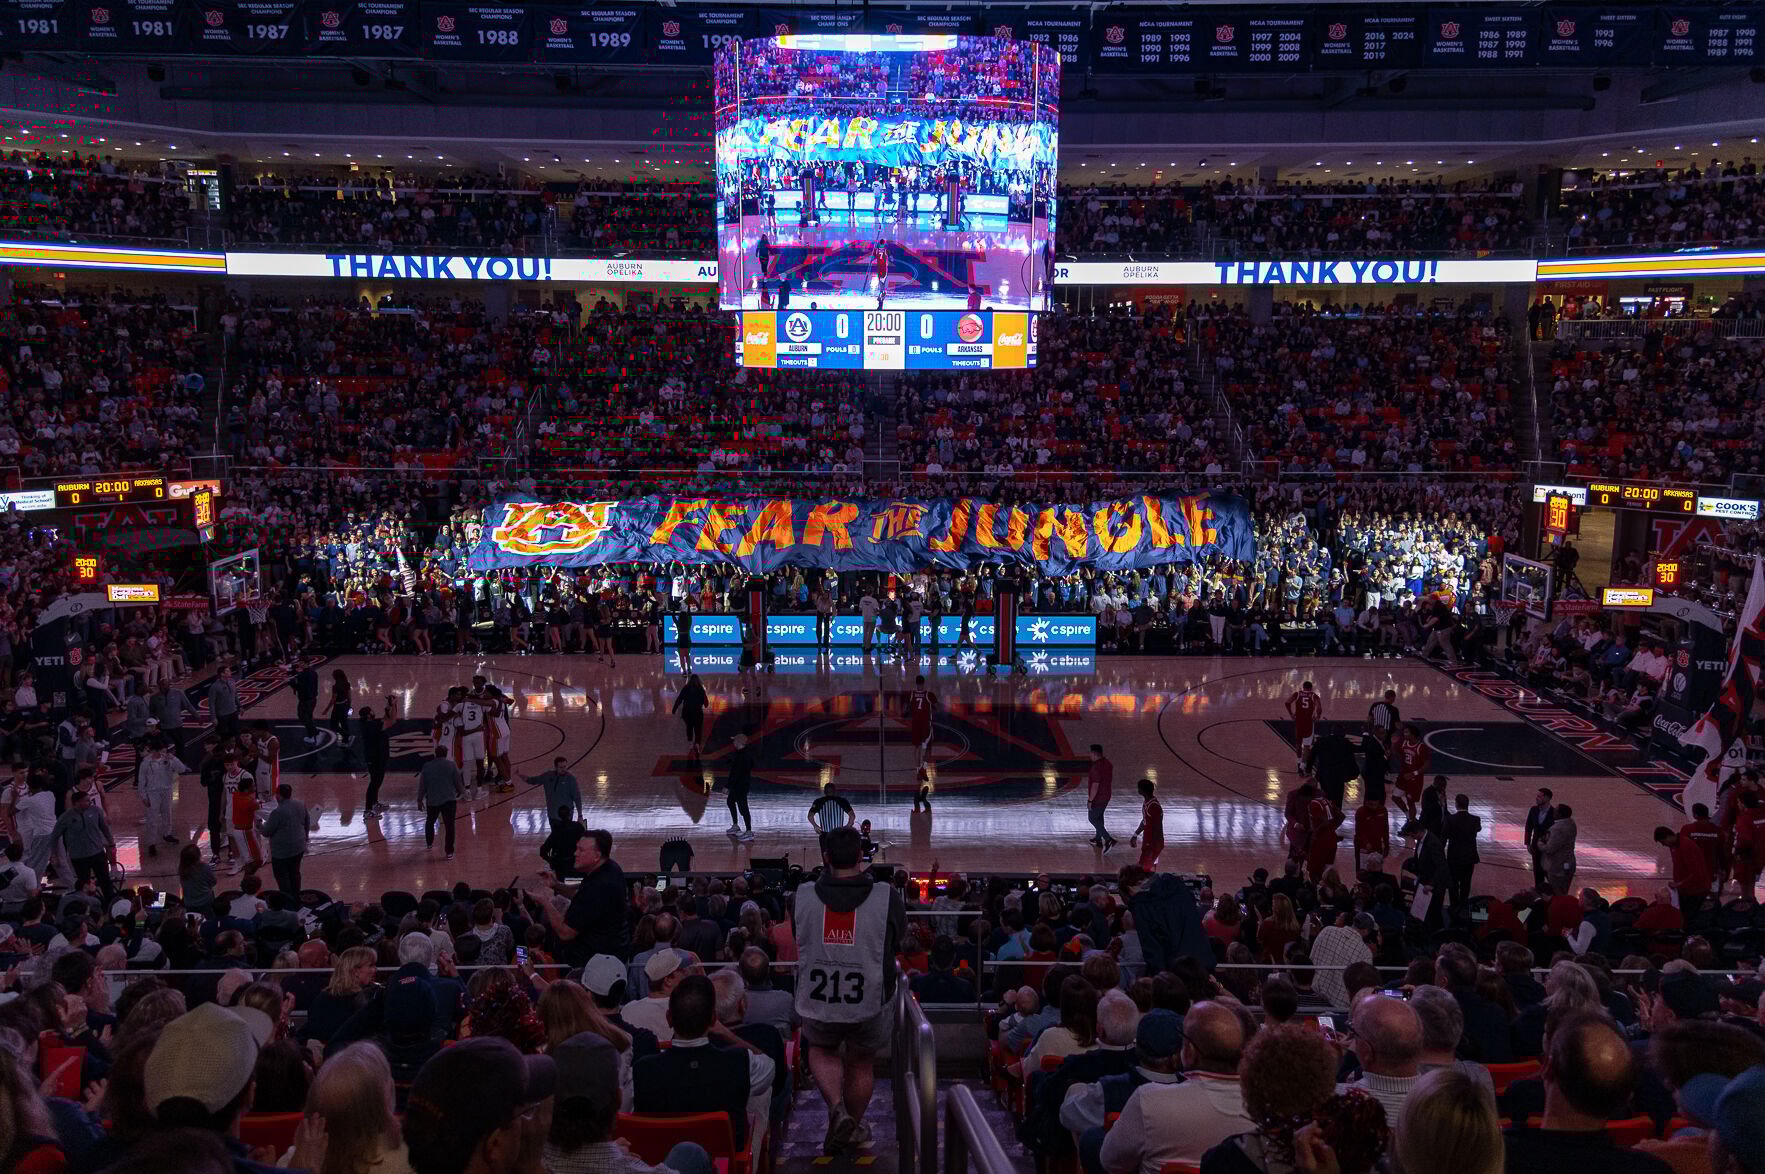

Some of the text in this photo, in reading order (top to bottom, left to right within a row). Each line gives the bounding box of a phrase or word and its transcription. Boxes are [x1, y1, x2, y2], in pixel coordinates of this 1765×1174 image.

[18, 19, 58, 34] 1981
[132, 21, 173, 36] 1981
[247, 24, 289, 39] 1987
[362, 25, 404, 40] 1987
[477, 30, 519, 45] 1988
[1252, 33, 1301, 41] 1997 2004
[1365, 32, 1386, 40] 2016
[1479, 31, 1500, 39] 1986
[1595, 29, 1614, 37] 1993
[590, 32, 631, 47] 1989
[1029, 34, 1079, 42] 1982 1986
[1141, 34, 1191, 42] 1989 1993
[1594, 39, 1613, 47] 1996
[1058, 44, 1079, 52] 1987
[1141, 44, 1191, 52] 1990 1994
[1251, 43, 1300, 51] 1999 2008
[1364, 42, 1386, 50] 2017
[1140, 54, 1190, 62] 1991 1996
[1249, 53, 1300, 61] 2000 2009
[1363, 52, 1385, 60] 2019
[1478, 50, 1524, 58] 1988 1991
[325, 254, 551, 280] THANK YOU!
[1215, 260, 1438, 284] THANK YOU!
[836, 313, 849, 339] 0
[867, 313, 901, 331] 20:00
[920, 313, 933, 339] 0
[788, 344, 808, 352] AUBURN
[957, 345, 983, 353] ARKANSAS
[58, 483, 90, 491] AUBURN
[95, 481, 129, 493] 20:00
[1590, 484, 1694, 499] AUBURN 20:00 ARKANSAS
[72, 493, 80, 504] 0
[155, 487, 163, 498] 0
[1601, 493, 1609, 504] 0
[1684, 500, 1692, 511] 0
[1715, 502, 1757, 512] COOK'S
[648, 492, 1217, 561] FEAR THE JUNGLE
[75, 558, 97, 567] 20:00
[1657, 563, 1678, 572] 20:00
[80, 567, 94, 578] 30
[1660, 572, 1674, 582] 30
[35, 656, 64, 666] YETI
[1696, 660, 1724, 670] YETI
[916, 697, 923, 710] 7
[1301, 697, 1310, 709] 5
[468, 710, 476, 721] 3
[827, 928, 853, 939] ALFA
[810, 968, 865, 1004] 213
